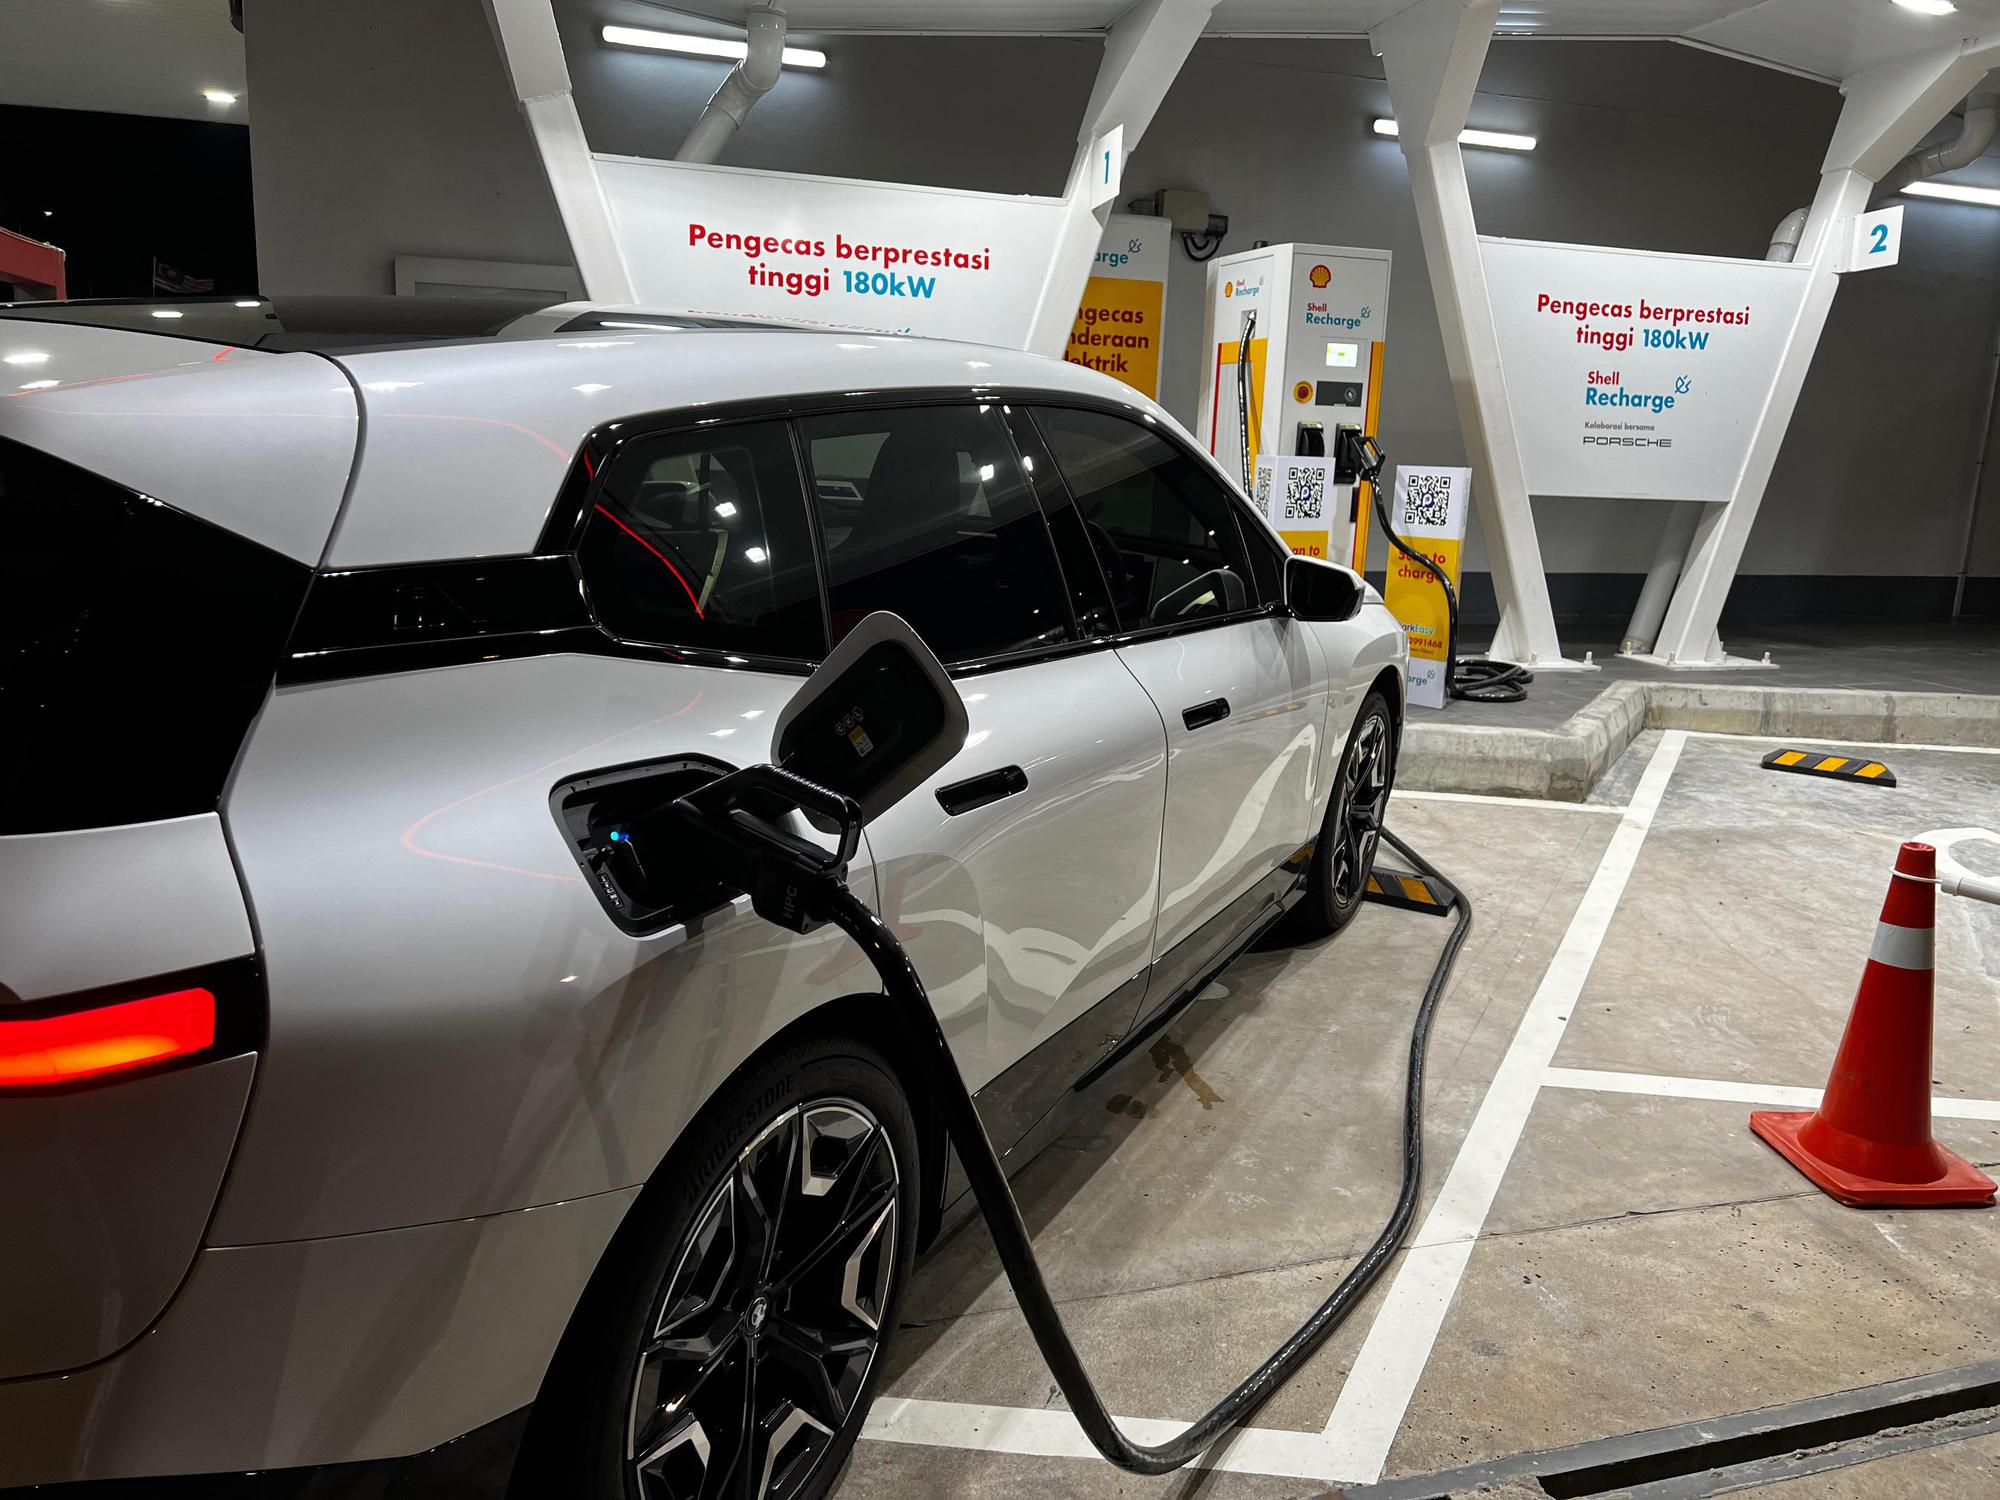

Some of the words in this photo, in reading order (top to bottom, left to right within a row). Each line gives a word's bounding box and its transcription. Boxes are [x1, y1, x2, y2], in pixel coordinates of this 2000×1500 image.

[1103, 149, 1111, 185] 1
[688, 223, 826, 259] Pengecas
[835, 234, 990, 270] berprestasi
[1869, 223, 1889, 254] 2
[1094, 251, 1129, 268] arge
[748, 262, 830, 297] tinggi
[843, 270, 936, 299] 180kW
[1306, 302, 1328, 312] Shell
[1537, 293, 1633, 321] Pengecas
[1639, 298, 1750, 327] berprestasi
[1305, 312, 1361, 329] Recharge
[1576, 324, 1634, 351] tinggi
[1643, 328, 1710, 350] 180kW
[1064, 350, 1129, 373] lektrik
[1587, 370, 1620, 385] Shell
[1585, 386, 1675, 413] Recharge
[1584, 421, 1623, 430] Kolaborasi
[1624, 422, 1655, 431] bersama
[1582, 436, 1672, 447] PORSCHE
[1292, 546, 1306, 556] an
[1433, 552, 1446, 564] to
[1398, 564, 1440, 584] charg
[1400, 623, 1434, 636] arkEasy
[783, 884, 799, 919] HPC
